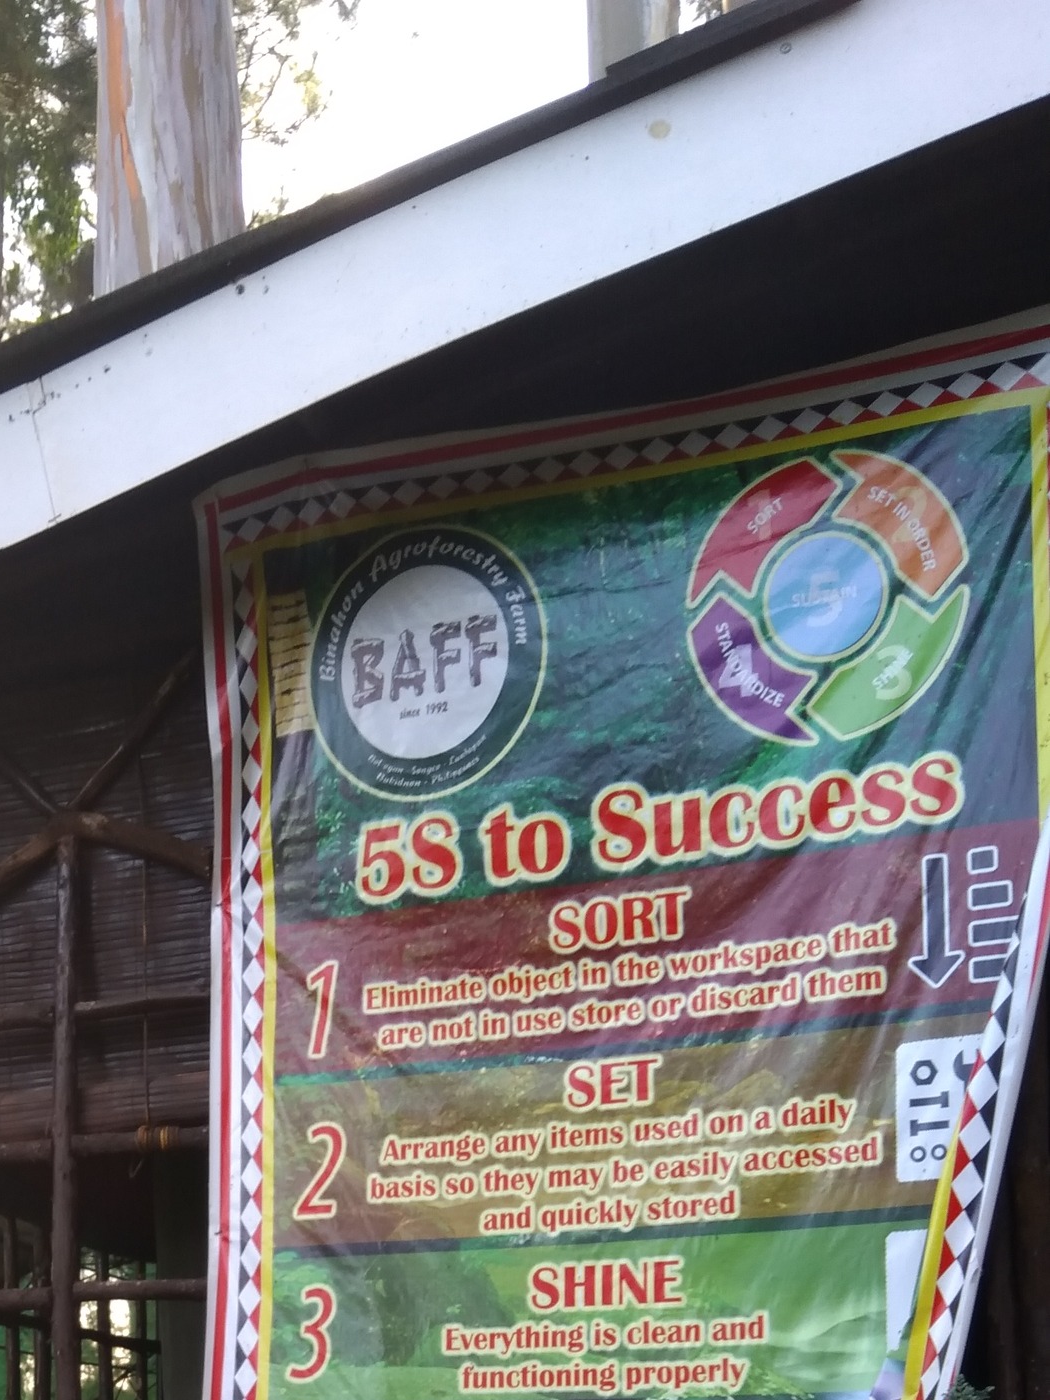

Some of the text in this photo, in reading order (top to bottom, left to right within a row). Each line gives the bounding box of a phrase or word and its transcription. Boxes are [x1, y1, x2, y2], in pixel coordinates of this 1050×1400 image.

[747, 497, 784, 534] SORT
[868, 486, 937, 572] SET IN ORDER
[319, 535, 528, 682] Binahon Agroforestry Farm
[351, 614, 498, 709] BAFF
[715, 622, 786, 708] STANDARDIZE
[399, 701, 448, 720] since 1992
[359, 757, 959, 897] 5S to Success
[552, 891, 688, 950] SORT
[365, 922, 894, 1010] Eliminate object in the workspace that
[307, 962, 338, 1056] 1
[381, 968, 884, 1046] are not in use store or discard them
[567, 1058, 659, 1108] SET
[383, 1098, 854, 1162] Arrange any items used on a daily
[296, 1124, 344, 1217] 2
[370, 1136, 879, 1200] basis so they may be easily accessed
[483, 1190, 737, 1233] and quickly stored
[530, 1260, 683, 1310] SHINE
[288, 1288, 335, 1380] 3
[444, 1314, 766, 1354] Everything is clean and
[461, 1357, 746, 1392] functioning properly
